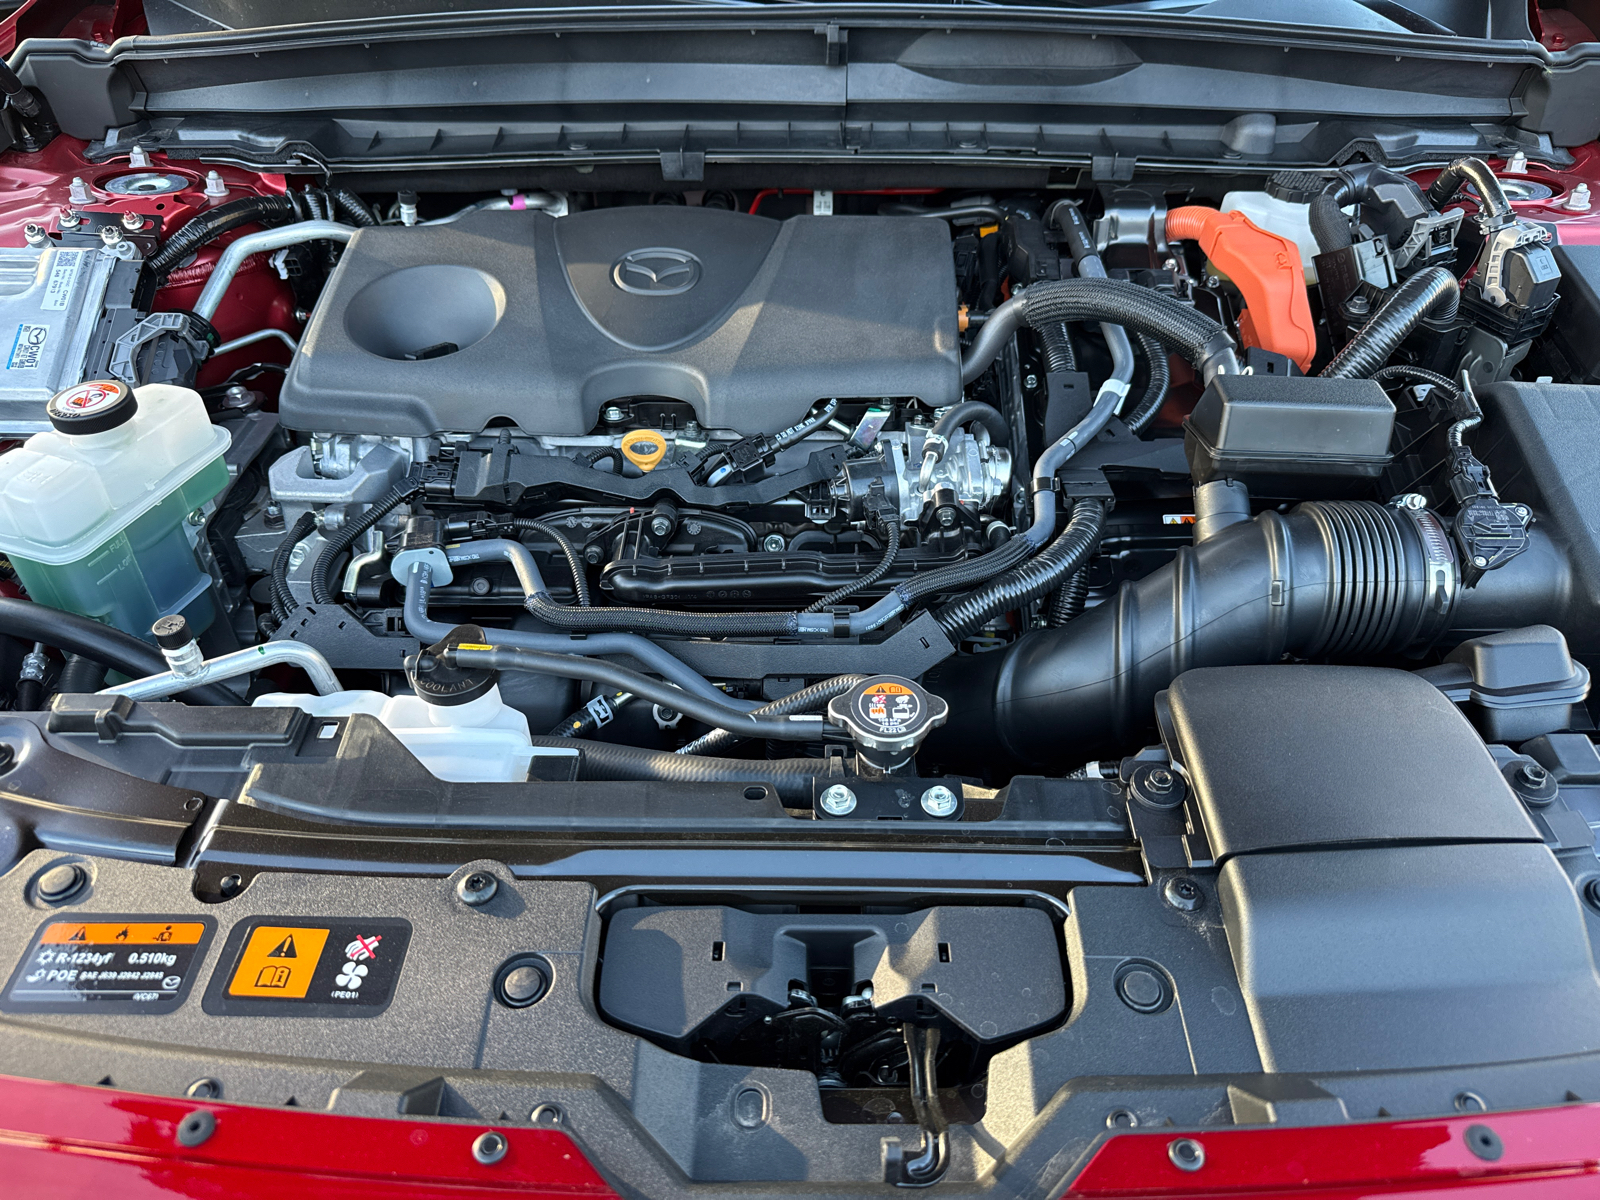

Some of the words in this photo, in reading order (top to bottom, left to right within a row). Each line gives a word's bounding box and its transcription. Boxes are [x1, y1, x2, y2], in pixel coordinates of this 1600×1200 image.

[25, 345, 40, 368] CW01
[419, 678, 475, 693] COOLANT
[54, 952, 114, 967] R-1234yf
[127, 952, 177, 967] 0.510kg
[46, 969, 79, 981] POE
[330, 990, 359, 999] (PE01)
